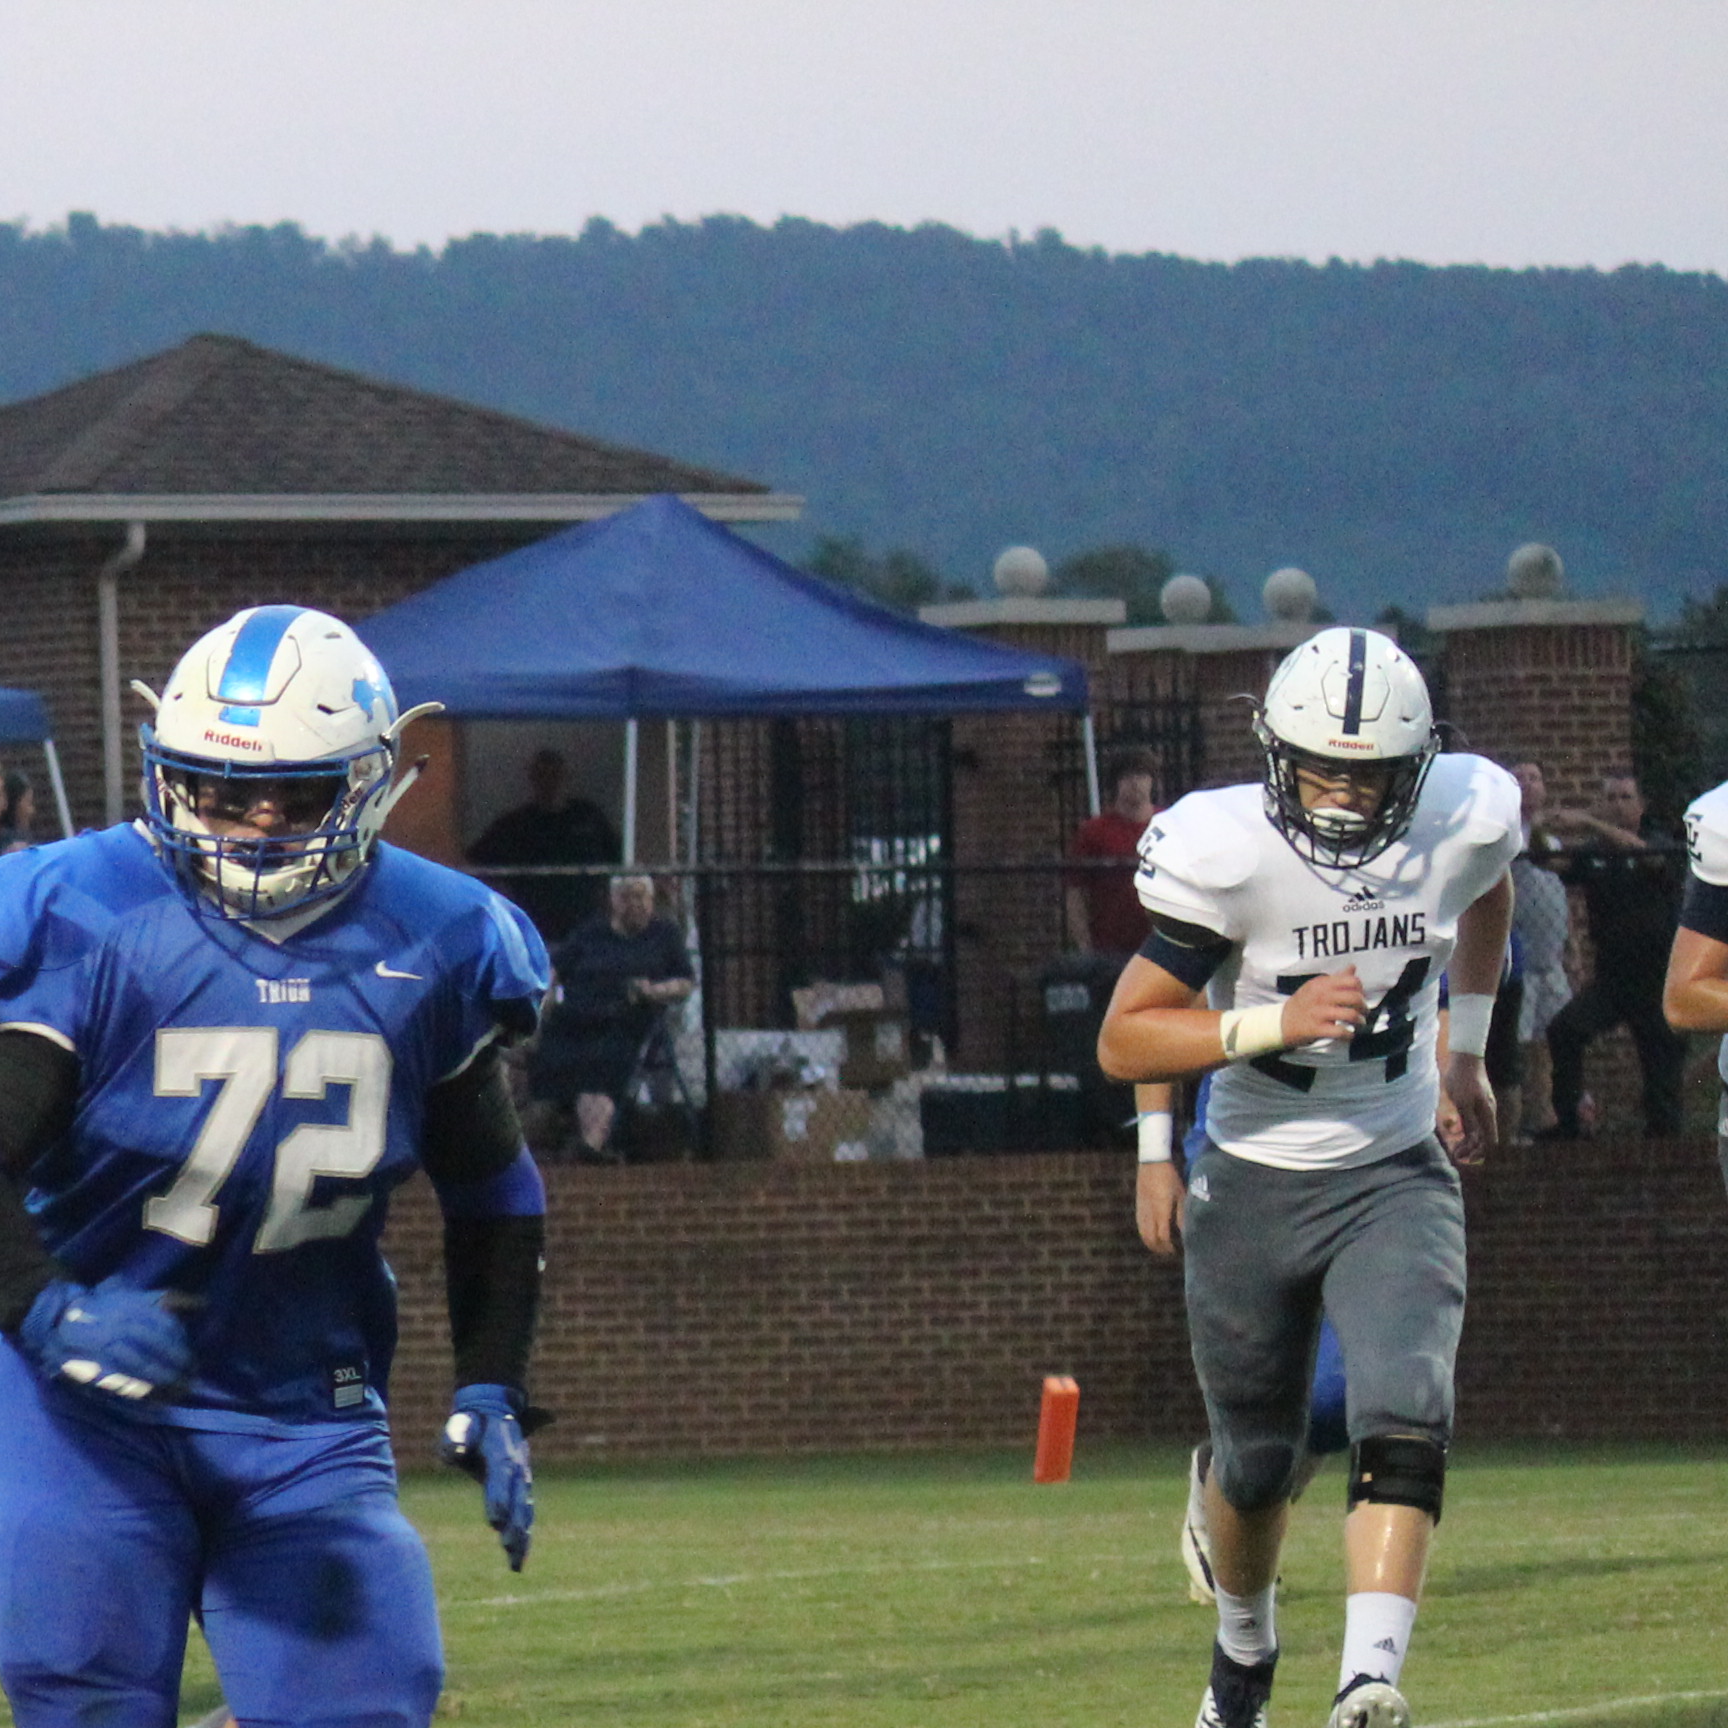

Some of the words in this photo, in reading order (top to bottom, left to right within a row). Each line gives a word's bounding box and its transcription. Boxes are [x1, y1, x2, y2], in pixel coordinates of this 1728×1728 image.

[1342, 901, 1385, 913] adidas
[1292, 912, 1426, 959] TROJANS
[255, 978, 311, 1004] TRION
[141, 1026, 394, 1256] 72
[333, 1366, 362, 1383] 3XL
